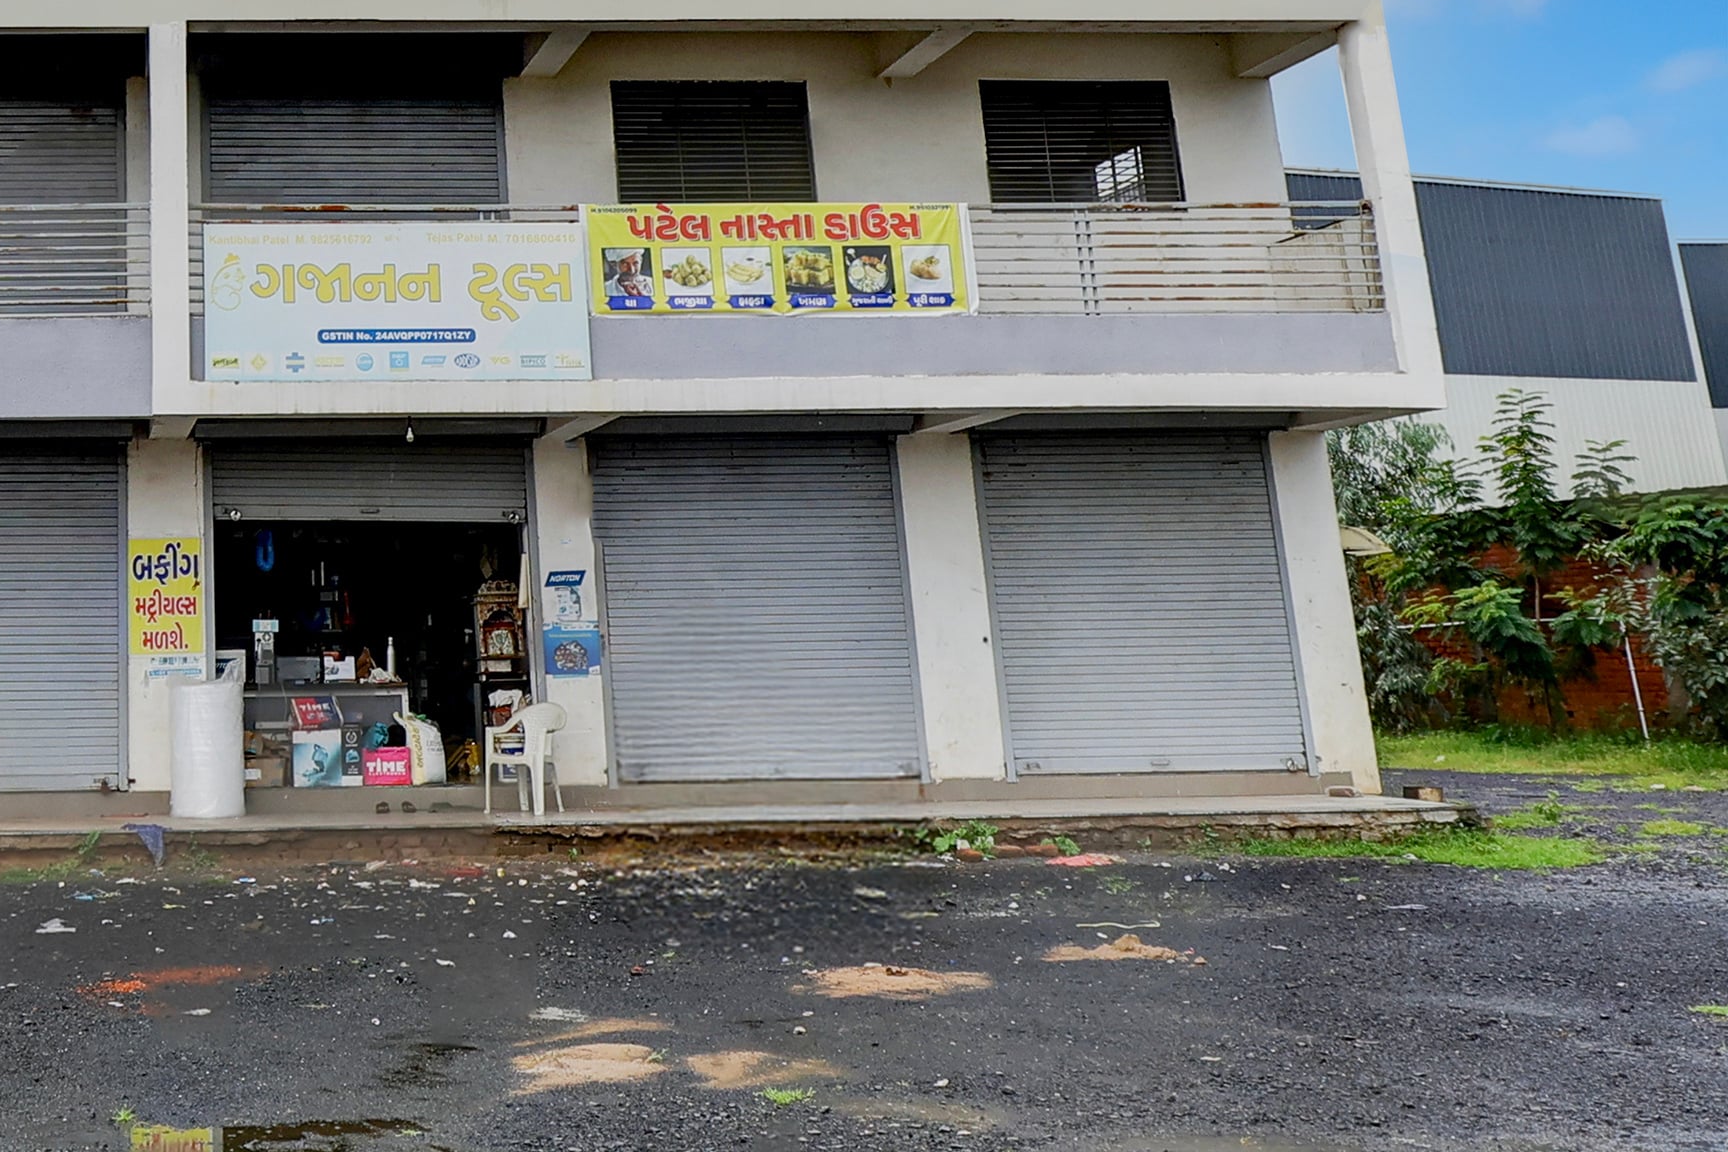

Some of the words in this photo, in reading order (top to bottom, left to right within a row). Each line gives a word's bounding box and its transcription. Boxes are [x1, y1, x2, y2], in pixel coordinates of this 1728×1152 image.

[626, 203, 711, 241] પટેલ
[721, 213, 815, 241] નાસ્તા
[263, 234, 289, 245] Patel
[249, 263, 442, 303] ગજાનન
[468, 263, 573, 322] ટૂલ્સ
[322, 332, 354, 341] GSTIN
[356, 331, 373, 341] No.
[549, 574, 581, 583] NORTON
[299, 702, 331, 711] TIME
[366, 757, 406, 773] TIME
